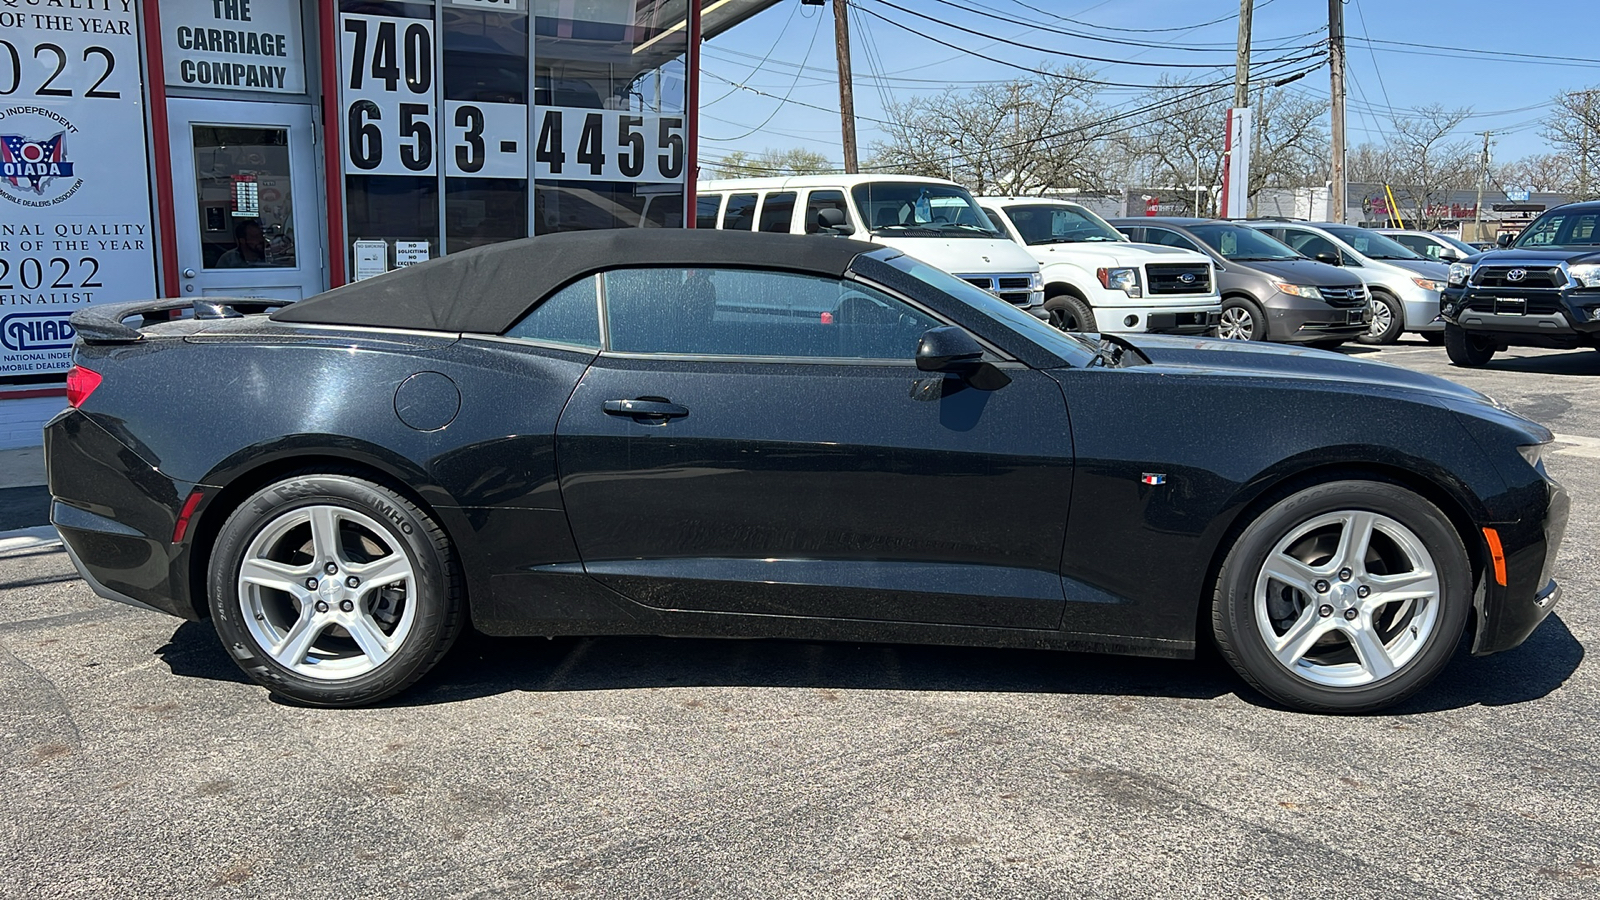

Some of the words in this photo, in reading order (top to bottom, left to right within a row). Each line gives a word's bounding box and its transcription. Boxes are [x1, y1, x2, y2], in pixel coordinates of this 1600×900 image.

[212, 0, 252, 21] THE
[0, 12, 25, 28] OF
[31, 14, 74, 31] THE
[78, 17, 132, 35] YEAR
[177, 26, 287, 57] CARRIAGE
[344, 19, 431, 94] 740
[181, 59, 286, 88] COMPANY
[6, 106, 79, 134] INDEPENDENT
[4, 163, 61, 176] OIADA
[22, 199, 51, 208] DEALERS
[52, 178, 84, 205] ASSOCIATION
[55, 224, 145, 237] QUALITY
[20, 240, 43, 251] OF
[53, 241, 89, 251] THE
[98, 240, 145, 250] YEAR
[0, 292, 93, 305] FINALIST
[4, 353, 45, 361] NATIONAL
[36, 361, 70, 370] DEALERS
